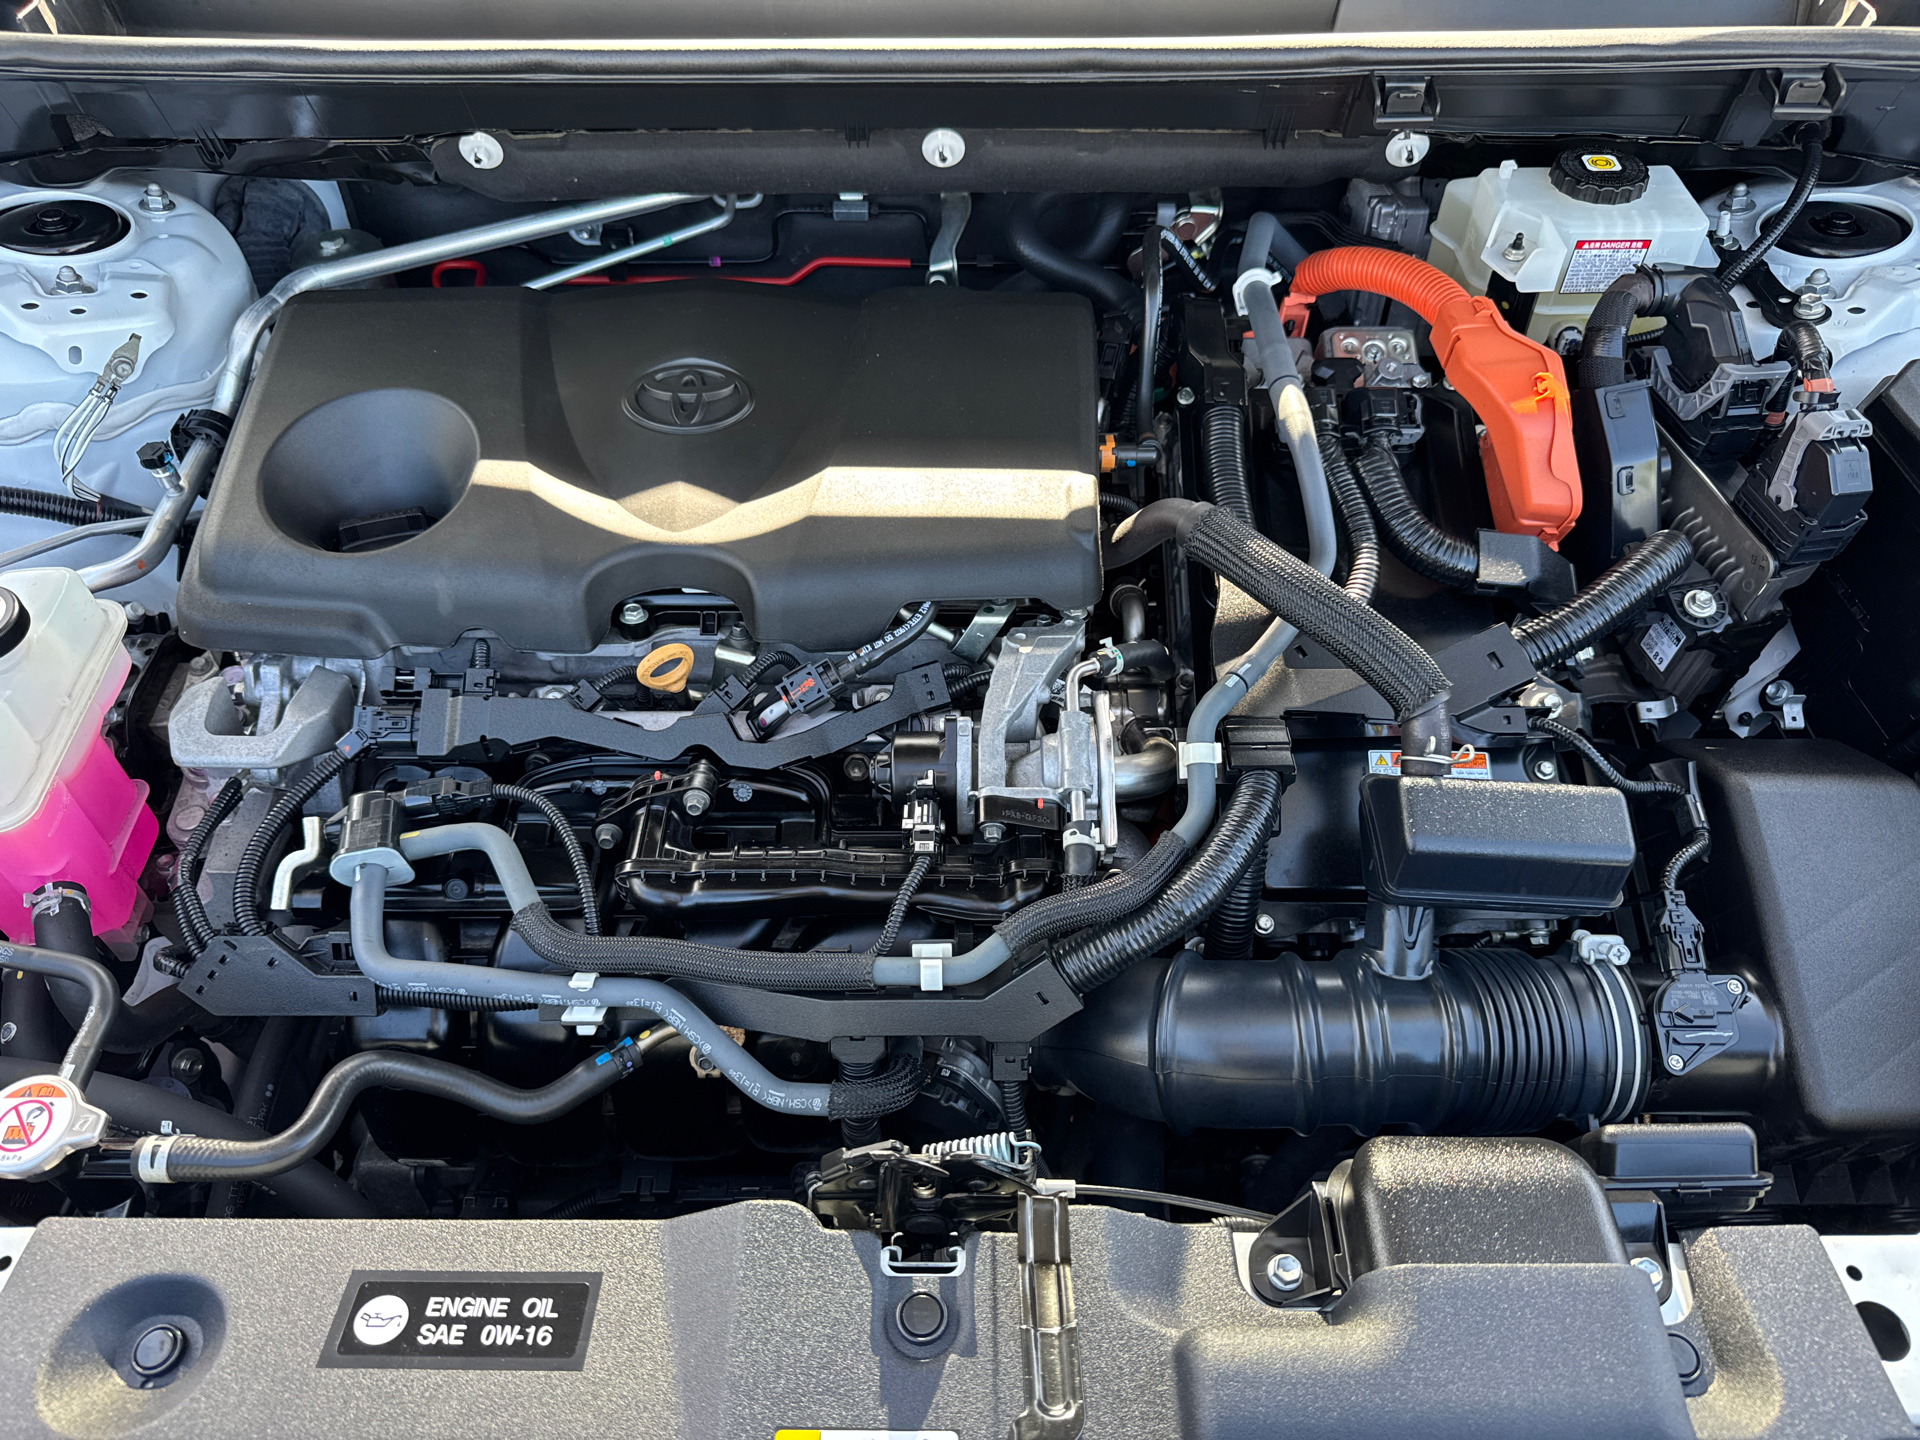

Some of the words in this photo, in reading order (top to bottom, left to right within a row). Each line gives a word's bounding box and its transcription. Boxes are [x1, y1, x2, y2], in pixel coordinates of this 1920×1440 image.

[1652, 651, 1664, 665] 89
[425, 1296, 511, 1318] ENGINE
[522, 1297, 559, 1318] OIL
[416, 1324, 467, 1345] SAE
[480, 1325, 553, 1346] 0W-16
